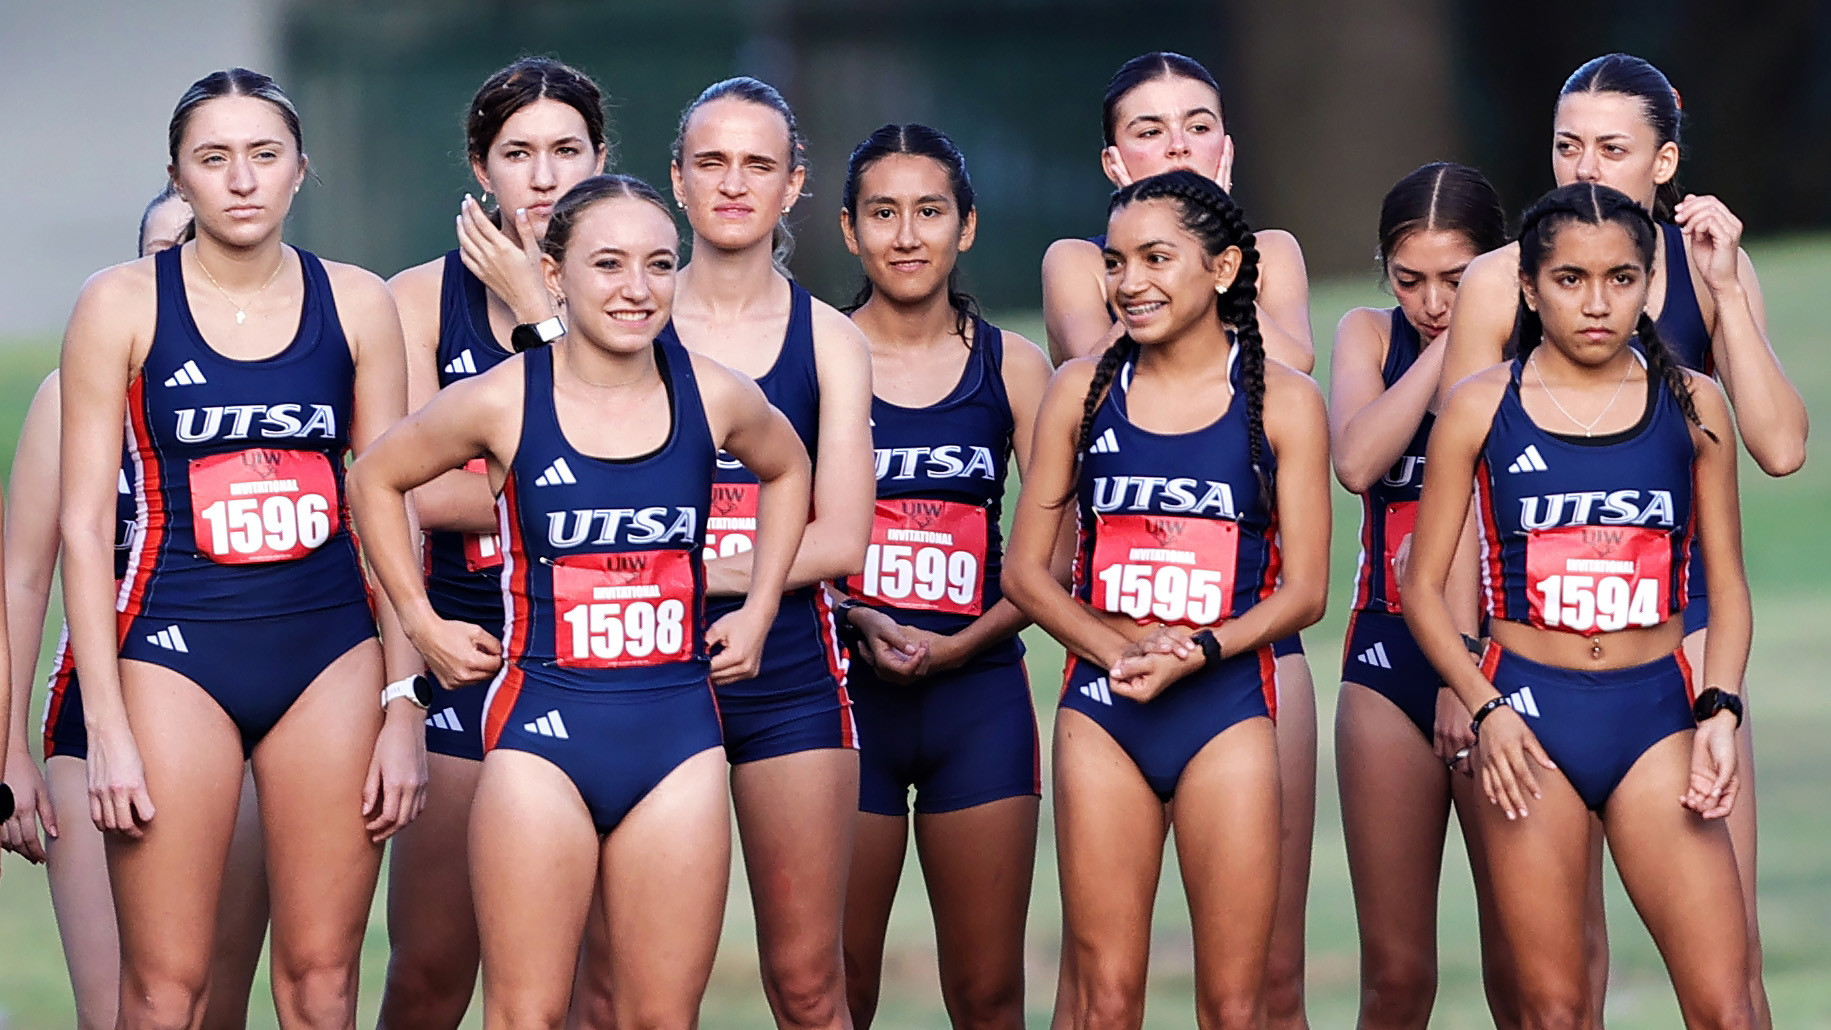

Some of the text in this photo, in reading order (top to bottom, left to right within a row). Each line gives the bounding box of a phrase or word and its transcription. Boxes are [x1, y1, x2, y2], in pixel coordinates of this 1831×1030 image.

[174, 403, 336, 443] UTSA
[230, 479, 299, 496] INVITATIONAL
[1092, 476, 1236, 519] UTSA
[201, 493, 330, 555] 1596
[546, 506, 697, 548] UTSA
[706, 517, 757, 530] ITATIONAL
[1519, 489, 1675, 532] UTSA
[887, 528, 953, 546] INVITATIONAL
[1129, 548, 1197, 564] INVITATIONAL
[863, 544, 977, 605] 1599
[1566, 558, 1635, 575] INVITATIONAL
[593, 584, 661, 600] INVITATIONAL
[1099, 564, 1222, 624] 1595
[1536, 575, 1660, 632] 1594
[563, 599, 685, 659] 1598
